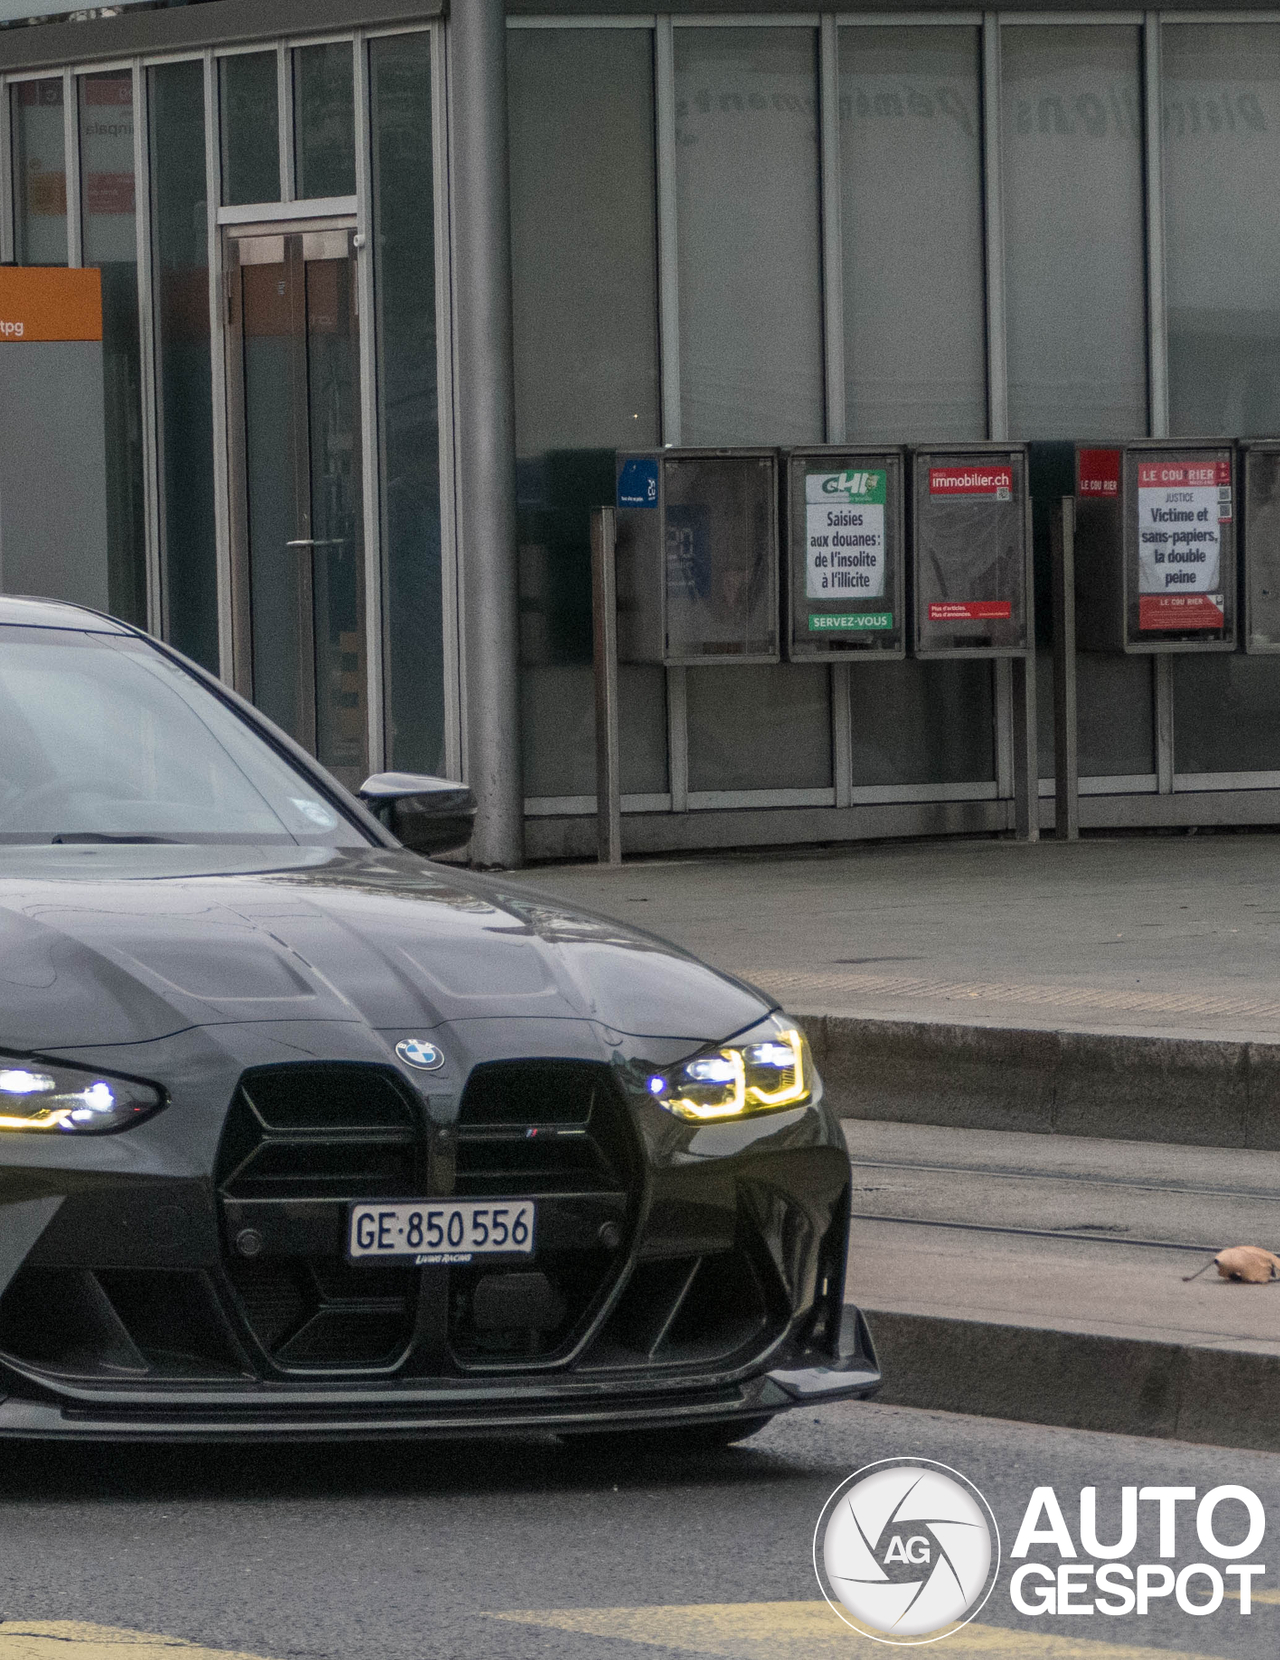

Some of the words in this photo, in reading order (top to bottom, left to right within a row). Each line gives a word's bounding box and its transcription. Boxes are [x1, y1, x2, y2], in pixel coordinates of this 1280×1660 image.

[0, 320, 24, 337] tpg
[932, 472, 1009, 487] immobilier.ch
[1142, 470, 1157, 481] LE
[1081, 480, 1089, 490] LE
[1165, 493, 1194, 503] JUSTICE
[827, 510, 864, 527] Saisies
[1151, 508, 1195, 522] Victime
[1197, 507, 1208, 521] et
[810, 535, 829, 547] aux
[1141, 528, 1218, 546] sans-papiers,
[814, 551, 828, 567] de
[831, 551, 877, 567] l'insolite
[1155, 549, 1165, 563] la
[1167, 548, 1206, 563] double
[822, 572, 828, 588] à
[831, 571, 870, 588] l'illicite
[1165, 569, 1197, 588] peine
[813, 616, 887, 627] SERVEZ-VOUS
